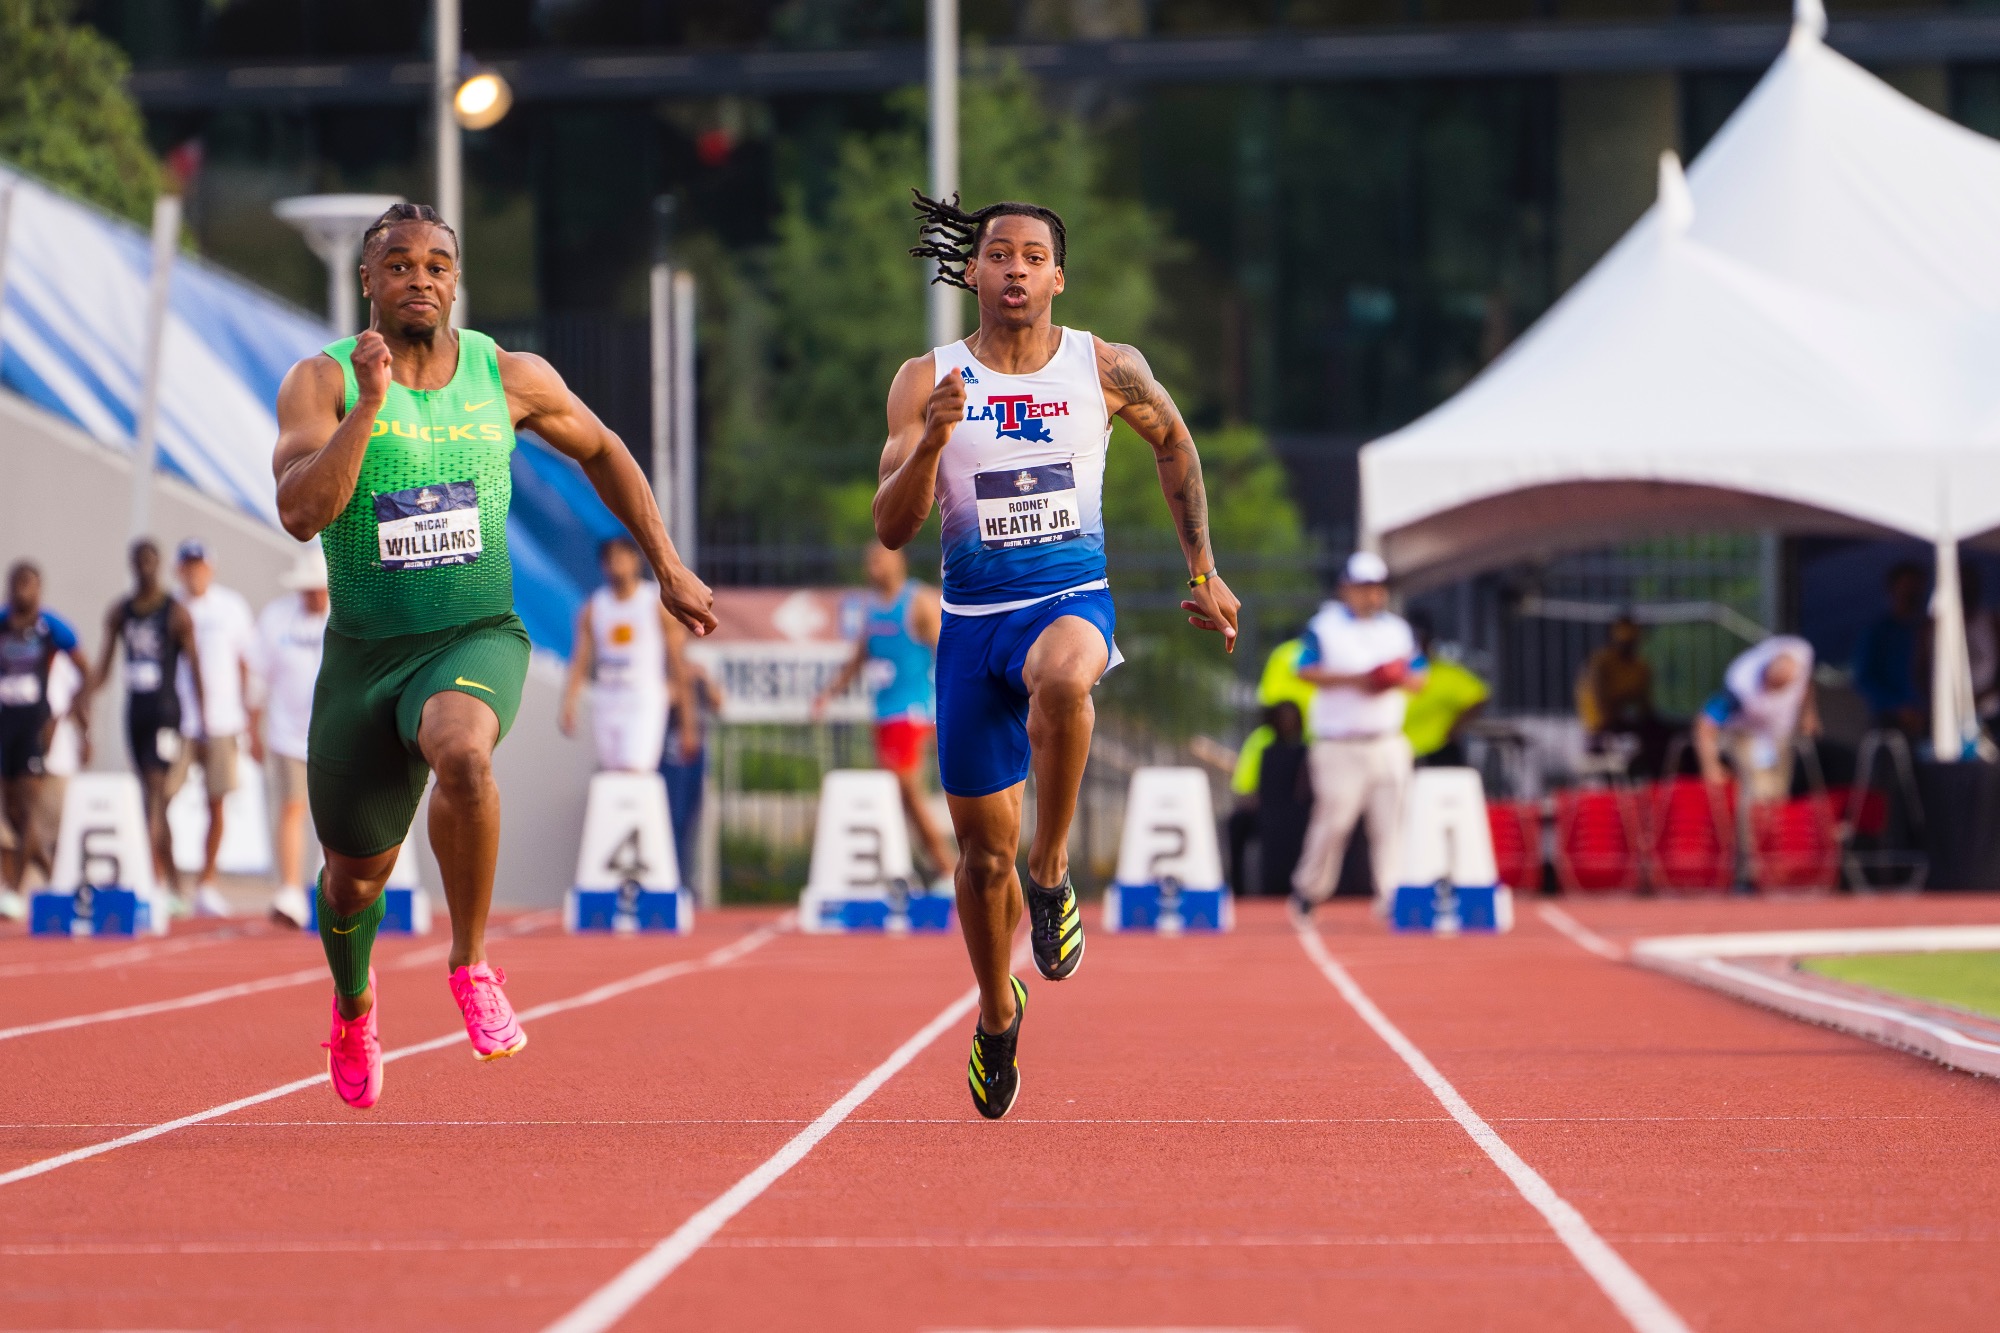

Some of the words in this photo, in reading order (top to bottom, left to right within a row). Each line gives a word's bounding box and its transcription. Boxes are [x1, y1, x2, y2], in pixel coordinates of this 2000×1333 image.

[966, 405, 995, 421] LA
[987, 394, 1070, 430] TECH
[370, 420, 503, 443] DUCKS
[1008, 498, 1049, 514] RODNEY
[414, 517, 448, 533] MICAH
[985, 512, 1042, 537] HEATH
[1048, 509, 1076, 530] JR.
[385, 528, 476, 557] WILLIAMS
[81, 826, 120, 888] 6
[605, 827, 650, 880] 4
[845, 825, 883, 888] 3
[1147, 823, 1186, 884] 2
